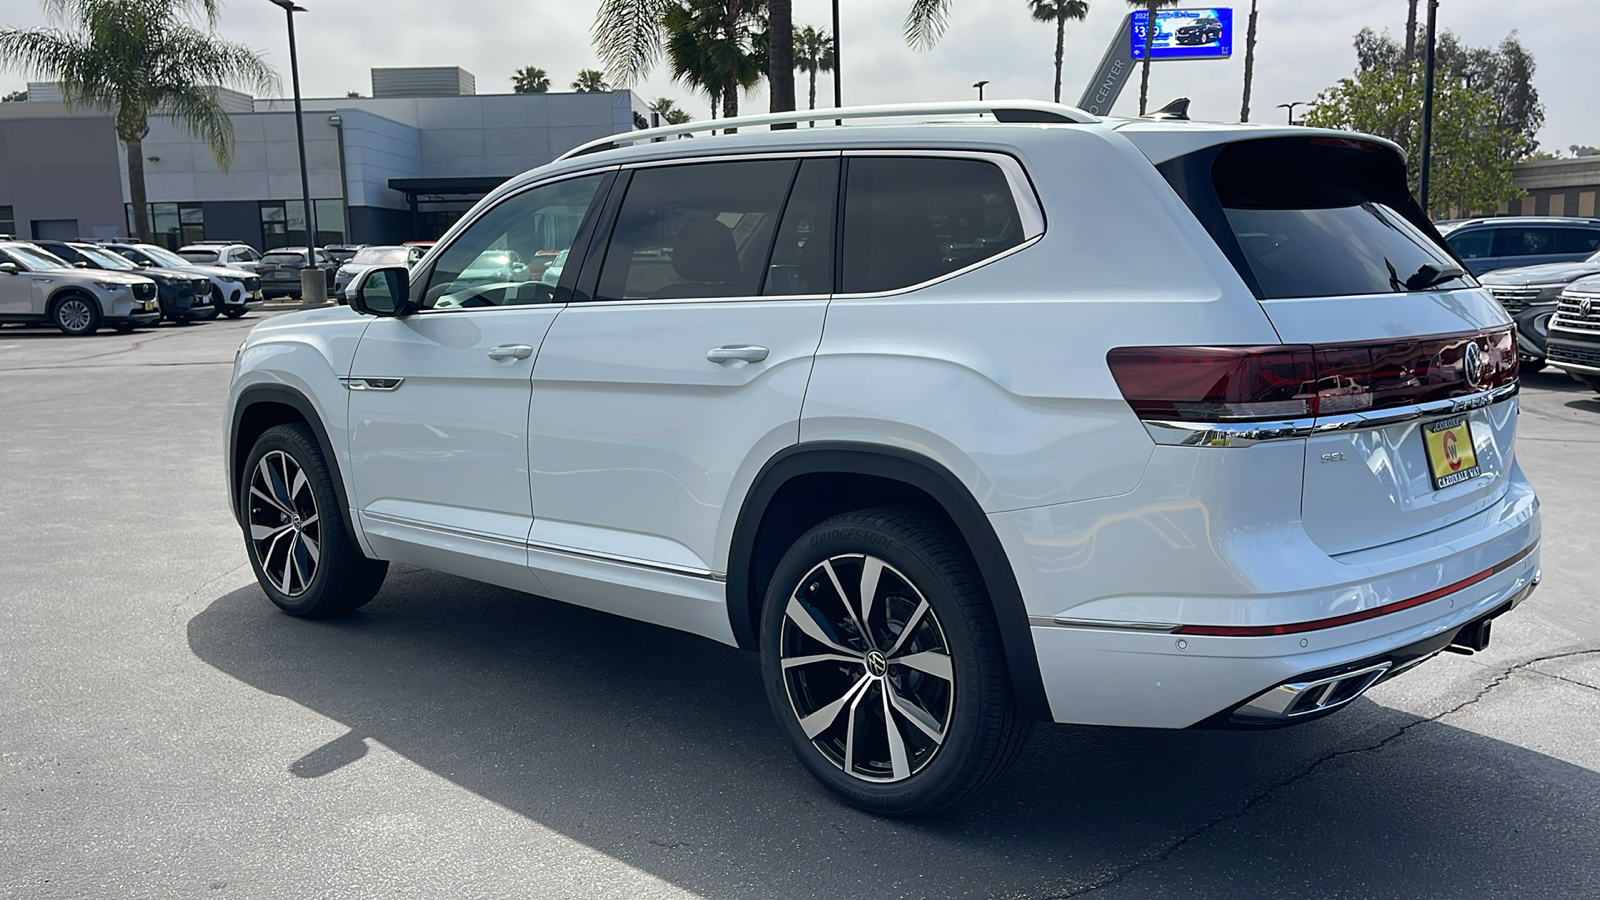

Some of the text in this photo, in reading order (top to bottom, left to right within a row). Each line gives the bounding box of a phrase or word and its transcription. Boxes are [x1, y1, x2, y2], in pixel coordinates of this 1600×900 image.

[1134, 26, 1160, 37] $39
[1095, 59, 1125, 104] CENTER
[1320, 451, 1347, 464] SEL
[1438, 466, 1481, 488] CARDINALE WAY
[810, 528, 895, 550] BRIDGESTONE
